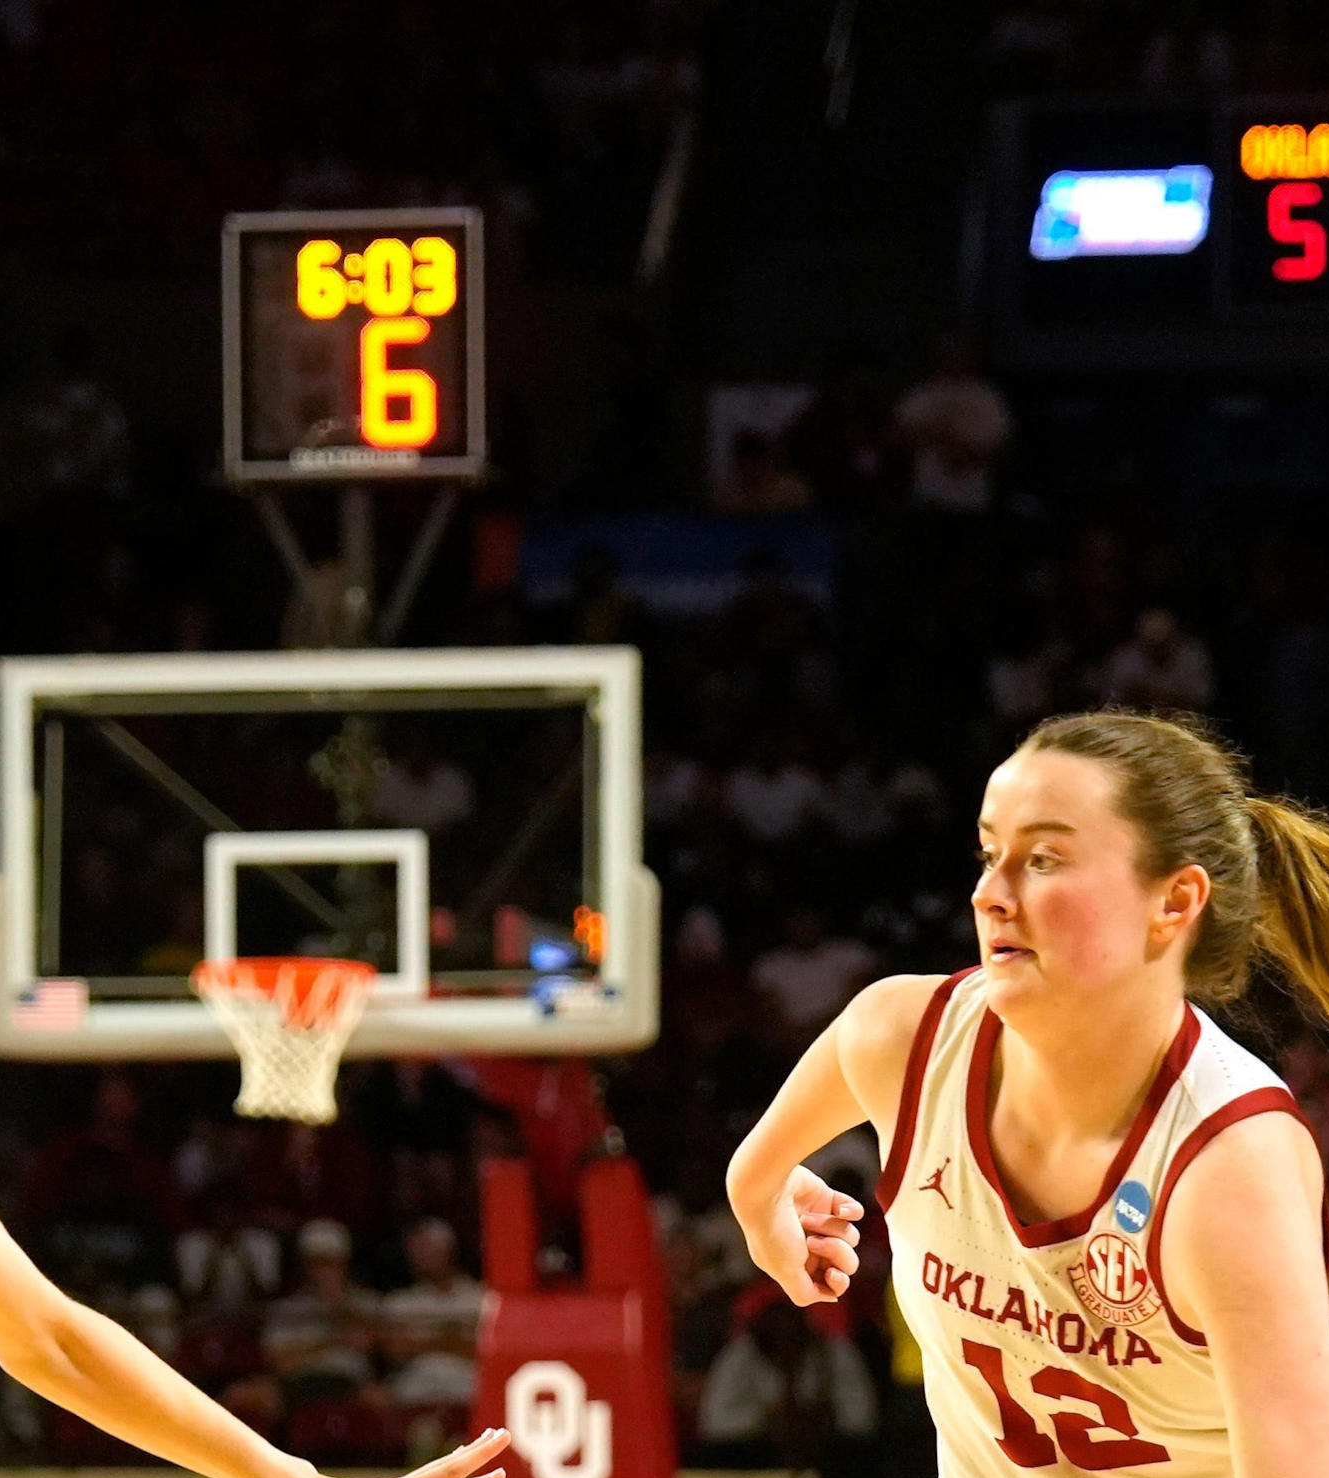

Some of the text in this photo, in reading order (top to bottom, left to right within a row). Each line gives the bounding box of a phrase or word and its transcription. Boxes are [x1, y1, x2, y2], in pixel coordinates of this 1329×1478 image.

[297, 237, 456, 320] 6:03
[360, 315, 437, 449] 6
[922, 1251, 1162, 1367] OKLAHOMA
[1077, 1284, 1151, 1323] GRADUATE
[1088, 1234, 1144, 1302] SEC
[960, 1337, 1172, 1471] 12
